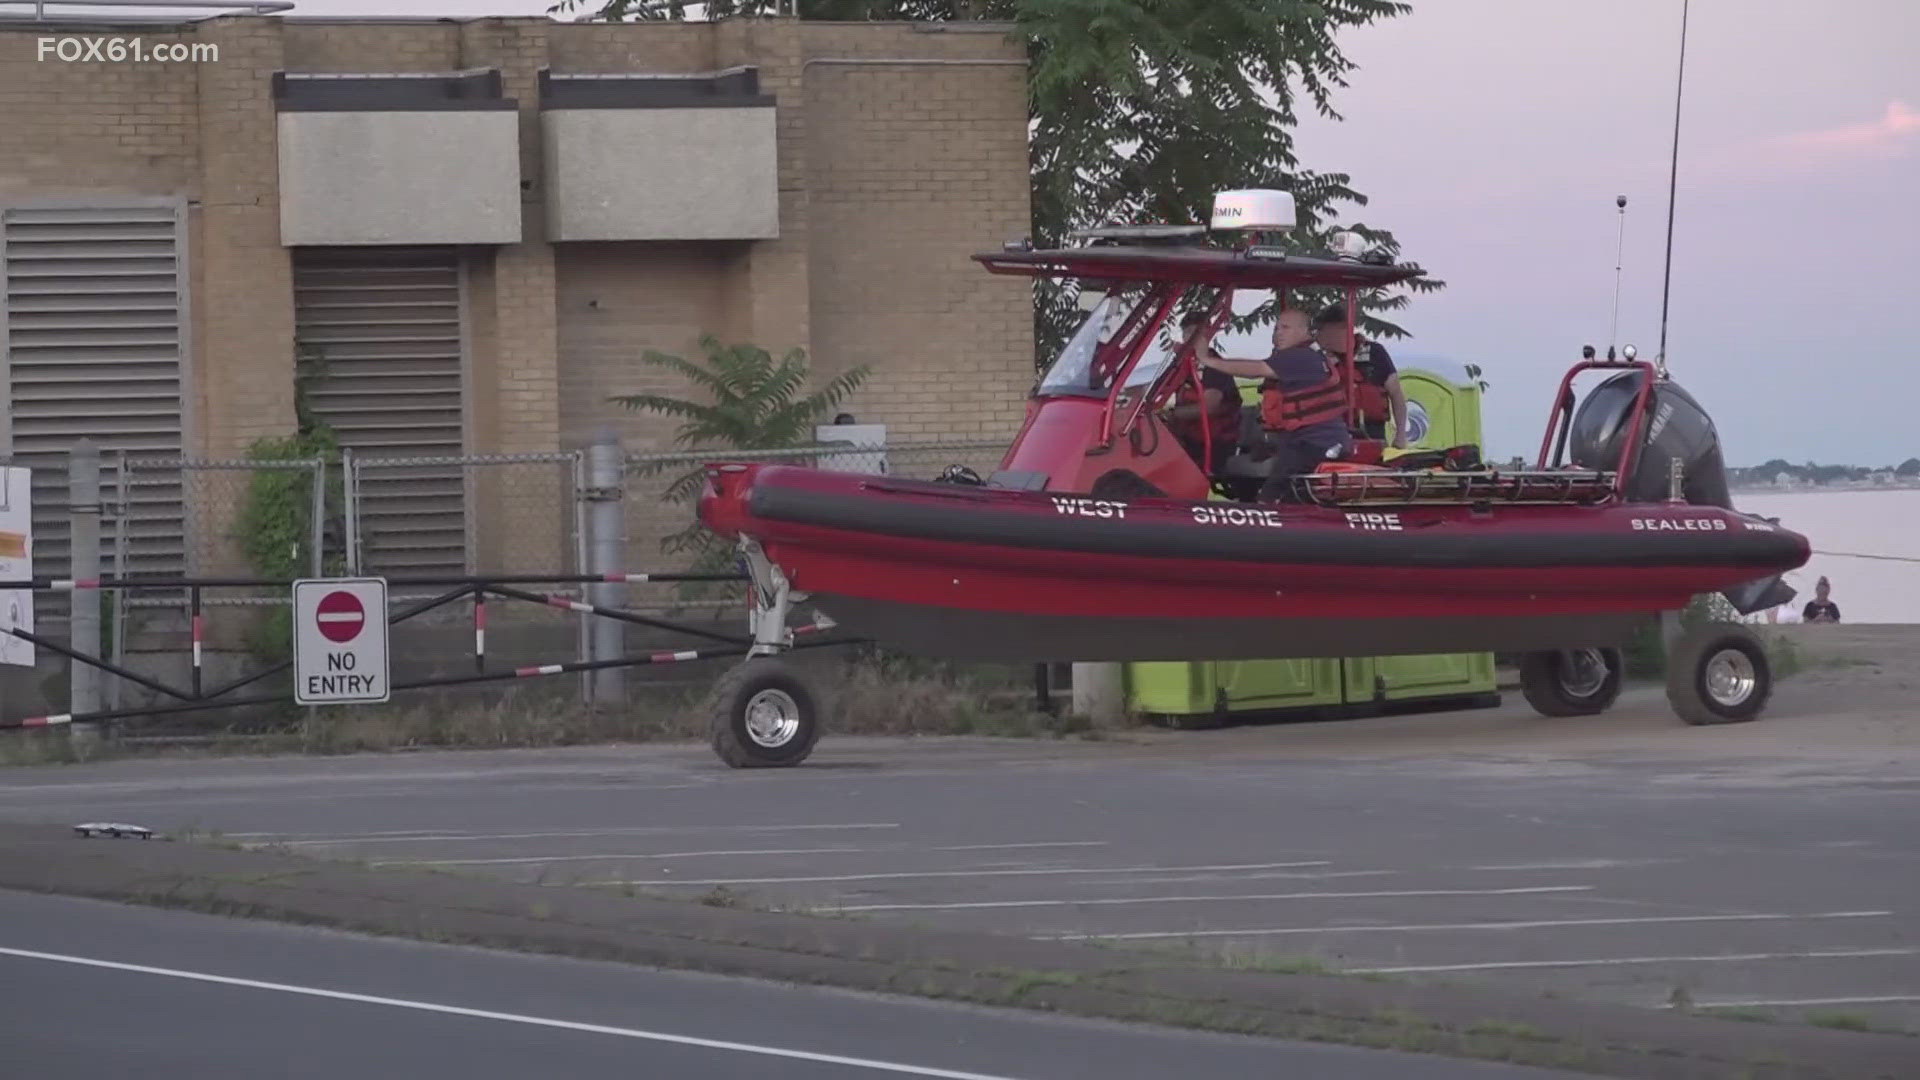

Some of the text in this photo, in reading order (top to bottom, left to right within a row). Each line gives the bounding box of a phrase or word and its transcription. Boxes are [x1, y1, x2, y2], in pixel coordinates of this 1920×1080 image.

[1051, 496, 1404, 530] WEST SHORE FIRE
[1630, 518, 1727, 531] SEALEGS
[328, 651, 356, 671] NO
[308, 674, 375, 694] ENTRY
